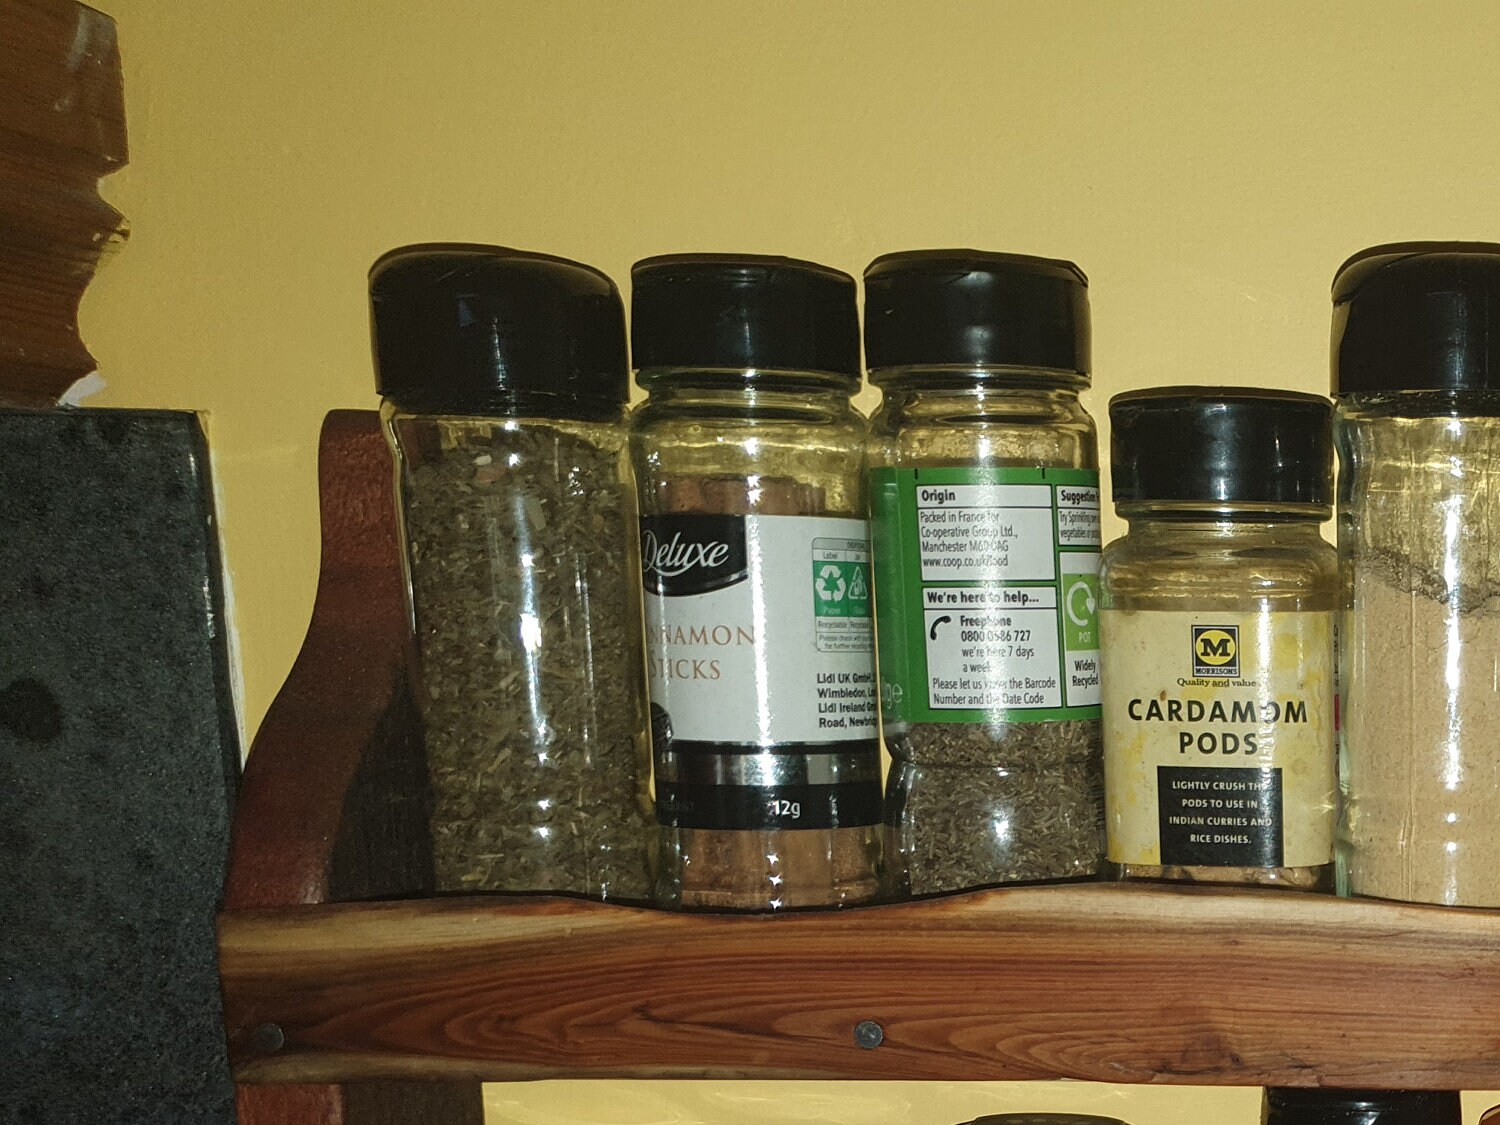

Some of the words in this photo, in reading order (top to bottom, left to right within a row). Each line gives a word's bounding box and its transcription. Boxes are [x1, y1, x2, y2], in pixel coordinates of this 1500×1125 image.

[921, 489, 956, 504] Origin
[920, 511, 946, 522] Packed
[948, 512, 956, 522] in
[921, 526, 969, 540] Co-operative
[922, 541, 967, 552] Manchester
[643, 530, 729, 577] Deluxe
[927, 591, 957, 603] We're
[960, 591, 984, 603] here
[1003, 591, 1039, 606] help...
[648, 624, 755, 646] NNAMON
[961, 630, 985, 641] 0800
[1014, 630, 1030, 641] 727
[1008, 646, 1013, 657] 7
[1016, 646, 1034, 659] days
[1200, 639, 1231, 657] M
[963, 664, 967, 672] a
[1074, 659, 1096, 673] Widely
[817, 673, 835, 683] Lidl
[838, 674, 850, 683] UK
[933, 678, 958, 689] Please
[960, 678, 971, 689] let
[973, 680, 982, 689] us
[1009, 678, 1022, 689] the
[1025, 677, 1056, 688] Barcode
[1072, 673, 1098, 689] Recycled
[1177, 678, 1210, 687] Quality
[1212, 679, 1230, 687] and
[1232, 679, 1256, 687] value
[934, 693, 966, 704] Number
[968, 693, 983, 704] and
[1003, 693, 1021, 703] Date
[1024, 693, 1044, 703] Code
[818, 703, 836, 713] Lidl
[1128, 699, 1308, 723] CARDAMOM
[819, 718, 847, 729] Road,
[1179, 732, 1258, 754] PODS
[1172, 781, 1210, 790] LIGHTLY
[1213, 782, 1245, 790] CRUSH
[773, 800, 800, 818] 12g
[1182, 799, 1207, 808] PODS
[1210, 800, 1222, 808] TO
[1226, 800, 1244, 808] USE
[1247, 800, 1258, 808] IN
[1207, 817, 1247, 826] CURRIES
[1190, 835, 1211, 843] RICE
[1214, 835, 1252, 843] DISHES.
